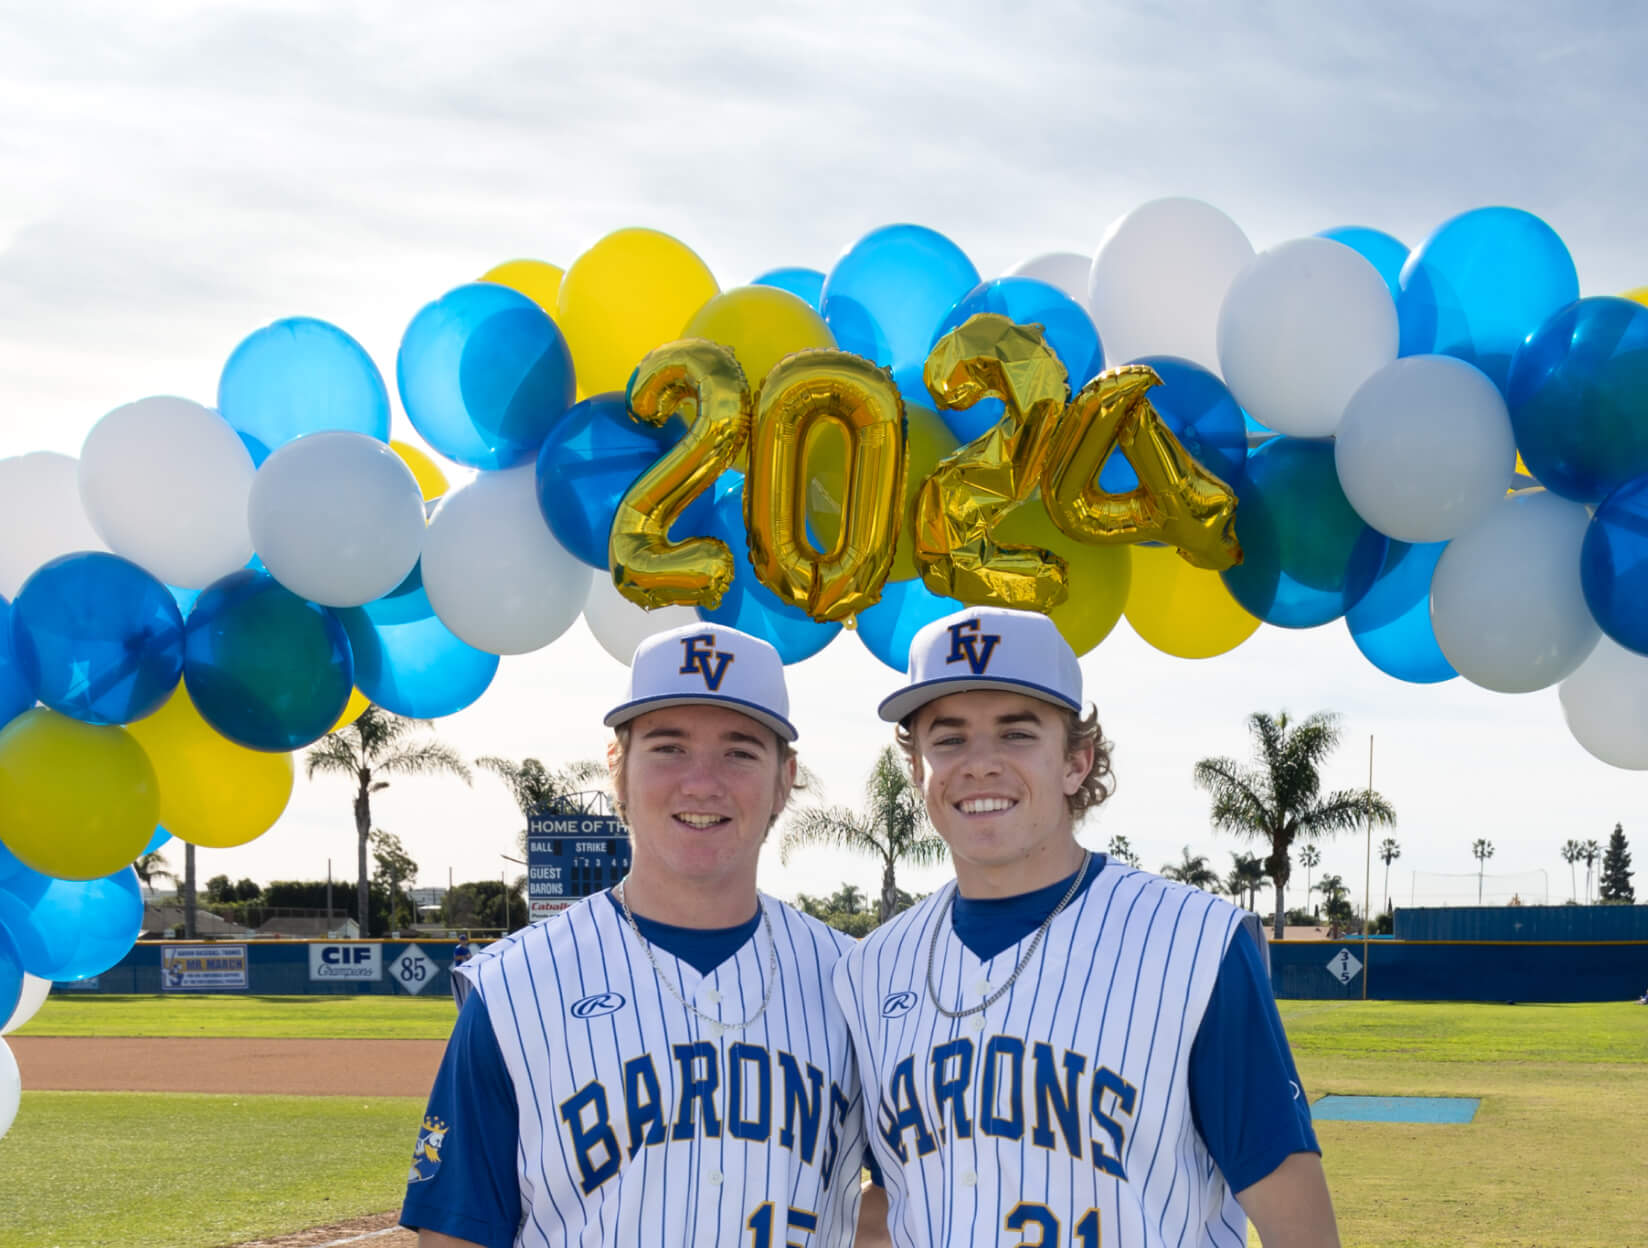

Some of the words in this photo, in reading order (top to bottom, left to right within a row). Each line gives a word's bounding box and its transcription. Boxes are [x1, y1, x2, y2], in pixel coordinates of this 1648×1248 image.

[611, 313, 1243, 624] 2024
[945, 618, 1001, 675] FV
[679, 633, 735, 691] FV
[530, 820, 578, 833] HOME
[581, 820, 604, 833] OF
[605, 820, 630, 833] TH
[530, 842, 553, 852] BALL
[575, 842, 607, 852] STRIKE
[530, 867, 562, 879] GUEST
[530, 882, 563, 894] BARONS
[531, 902, 572, 911] Caball
[321, 946, 371, 964] CIF
[400, 957, 426, 981] 85
[559, 1041, 850, 1197] BARONS
